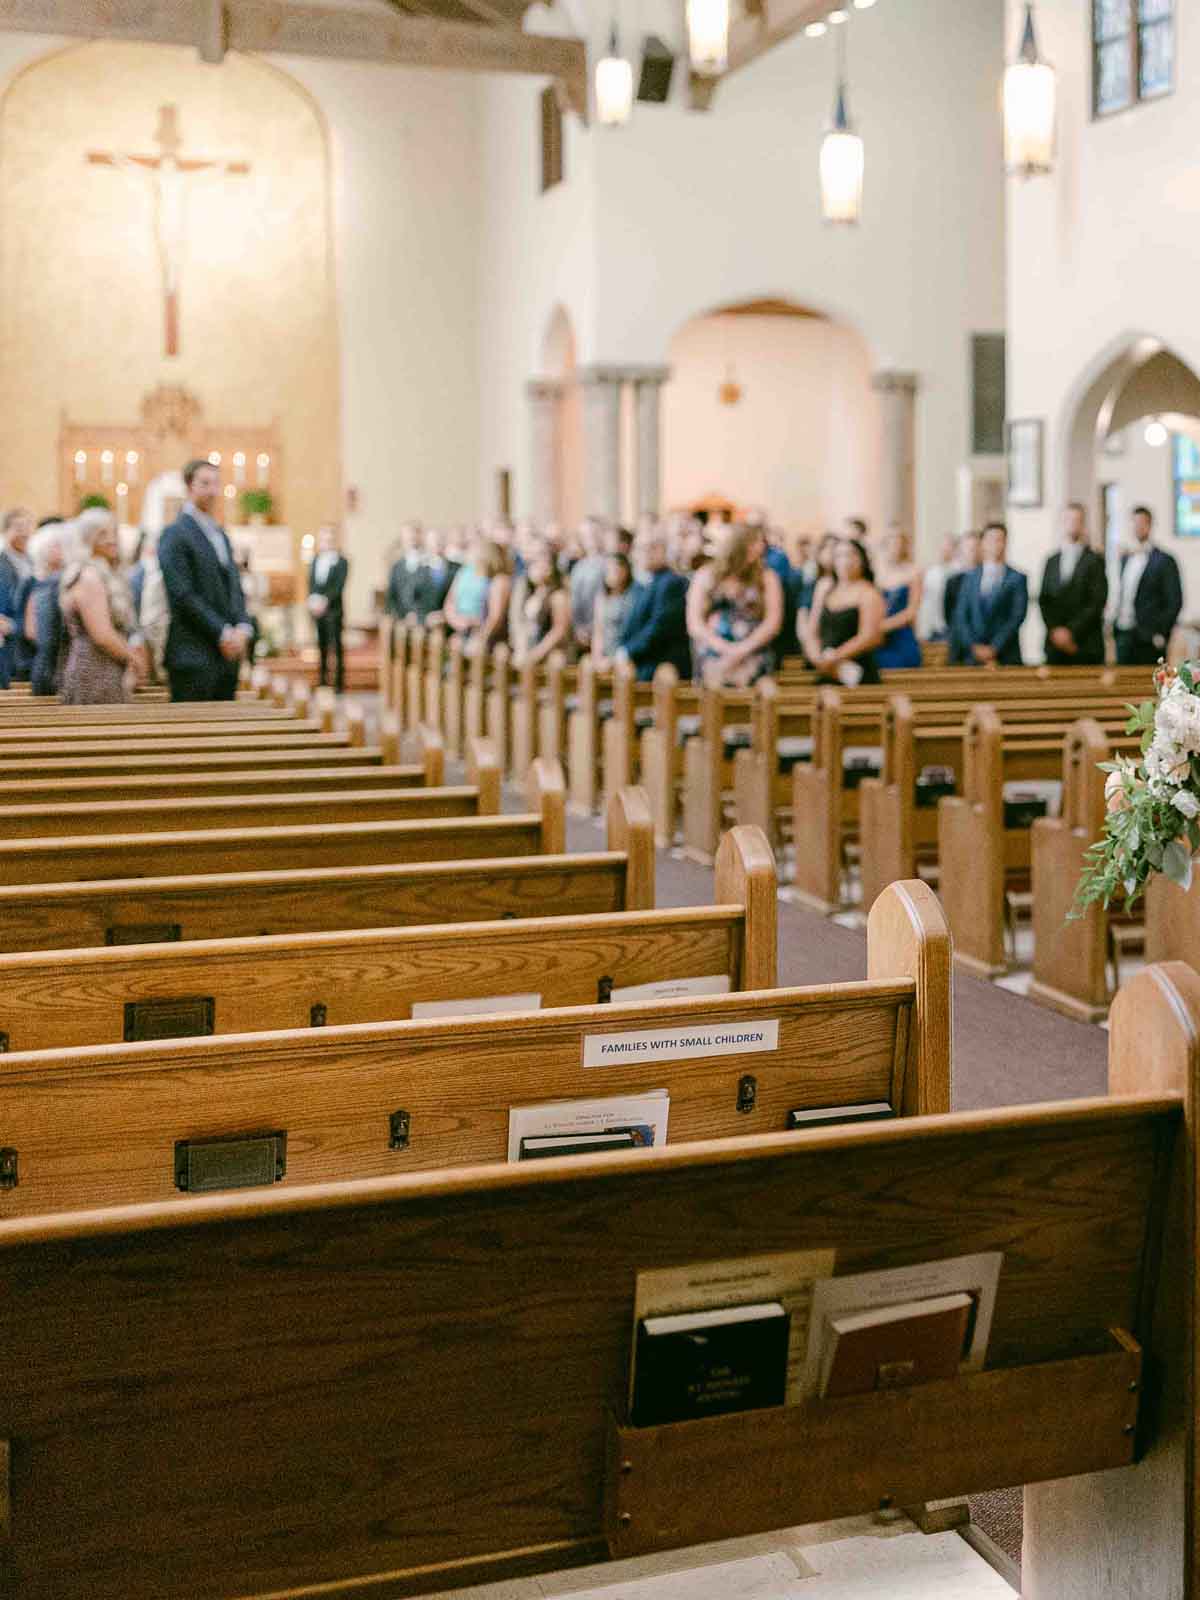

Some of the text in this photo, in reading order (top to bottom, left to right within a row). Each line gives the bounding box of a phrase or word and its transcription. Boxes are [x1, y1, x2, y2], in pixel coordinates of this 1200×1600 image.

[601, 1033, 763, 1054] FAMILIES WITH SMALL CHILDREN
